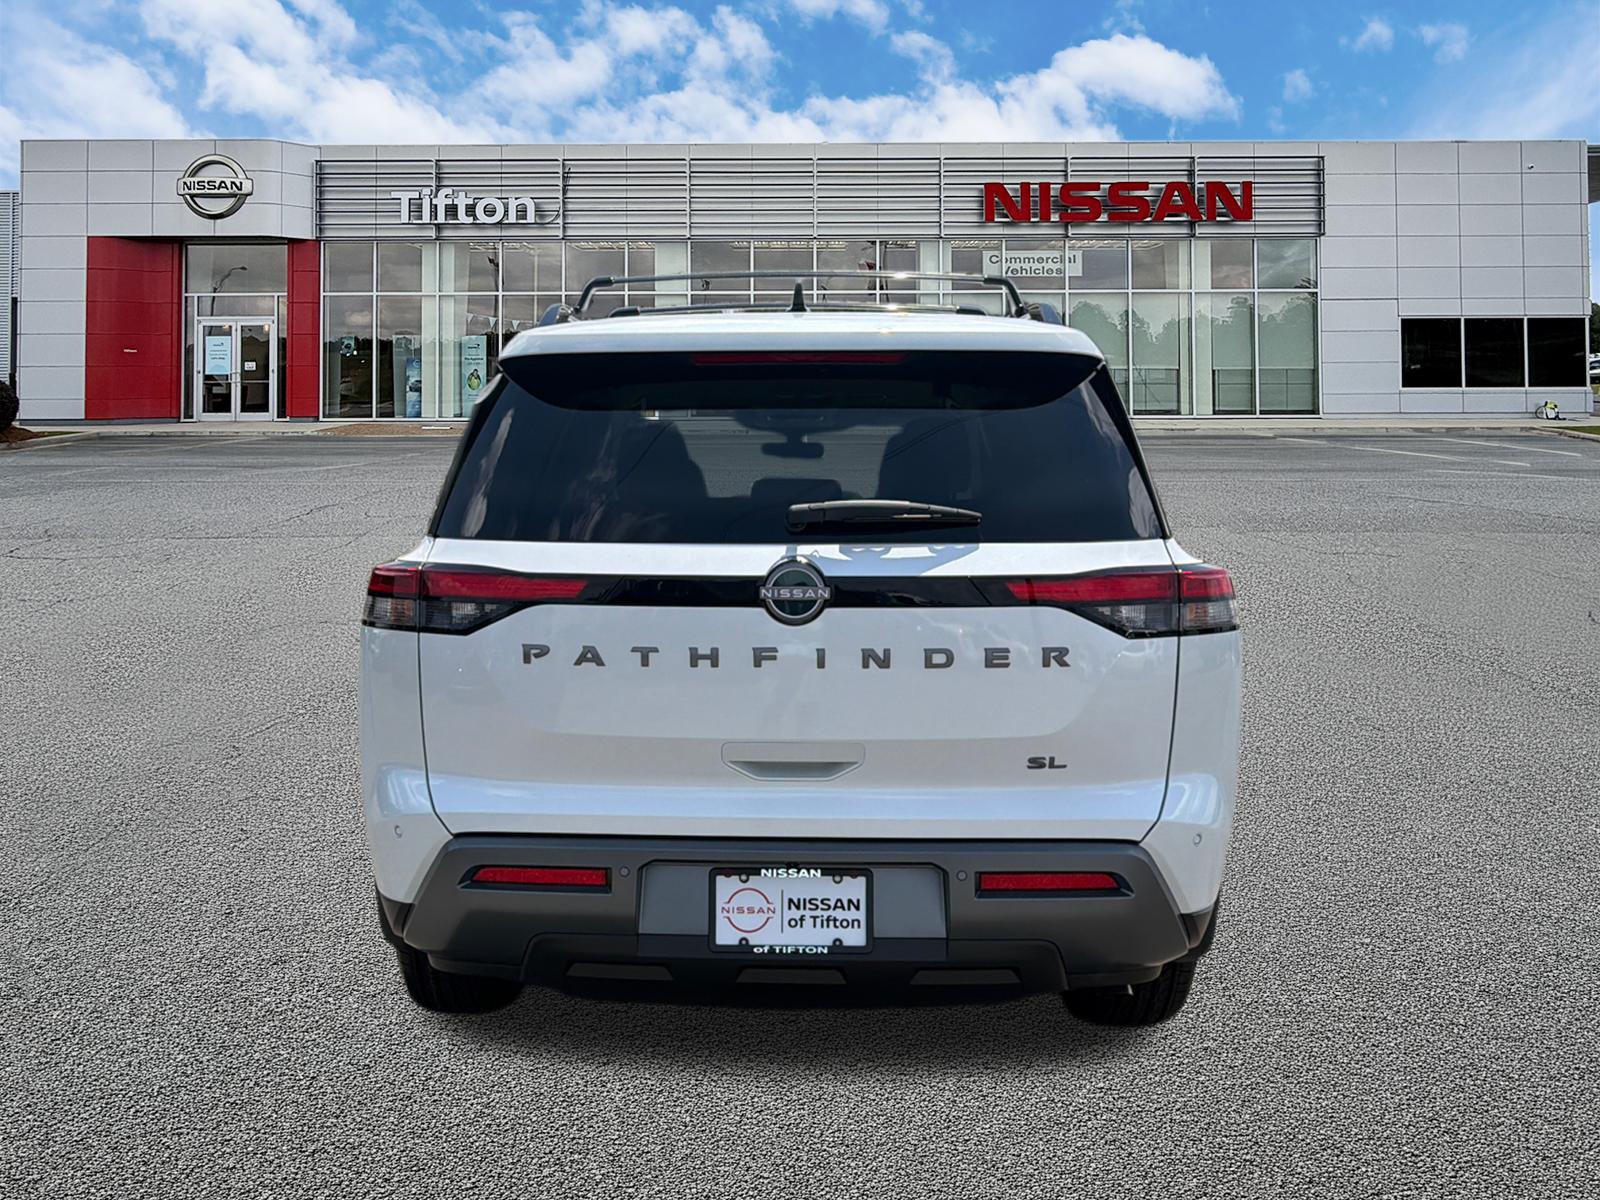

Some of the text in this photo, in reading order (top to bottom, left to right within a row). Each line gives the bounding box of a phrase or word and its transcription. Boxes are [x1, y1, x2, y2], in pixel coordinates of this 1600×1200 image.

[182, 180, 243, 191] NISSAN
[391, 188, 536, 224] Tifton
[984, 181, 1253, 222] NISSAN
[761, 588, 829, 598] NISSAN
[522, 643, 1071, 669] PATHFINDER
[1027, 756, 1067, 770] SL
[761, 868, 822, 878] NISSAN
[721, 906, 776, 914] NISSAN
[787, 898, 861, 911] NISSAN
[787, 915, 861, 929] of Tifton
[753, 946, 828, 954] of TIFTON
